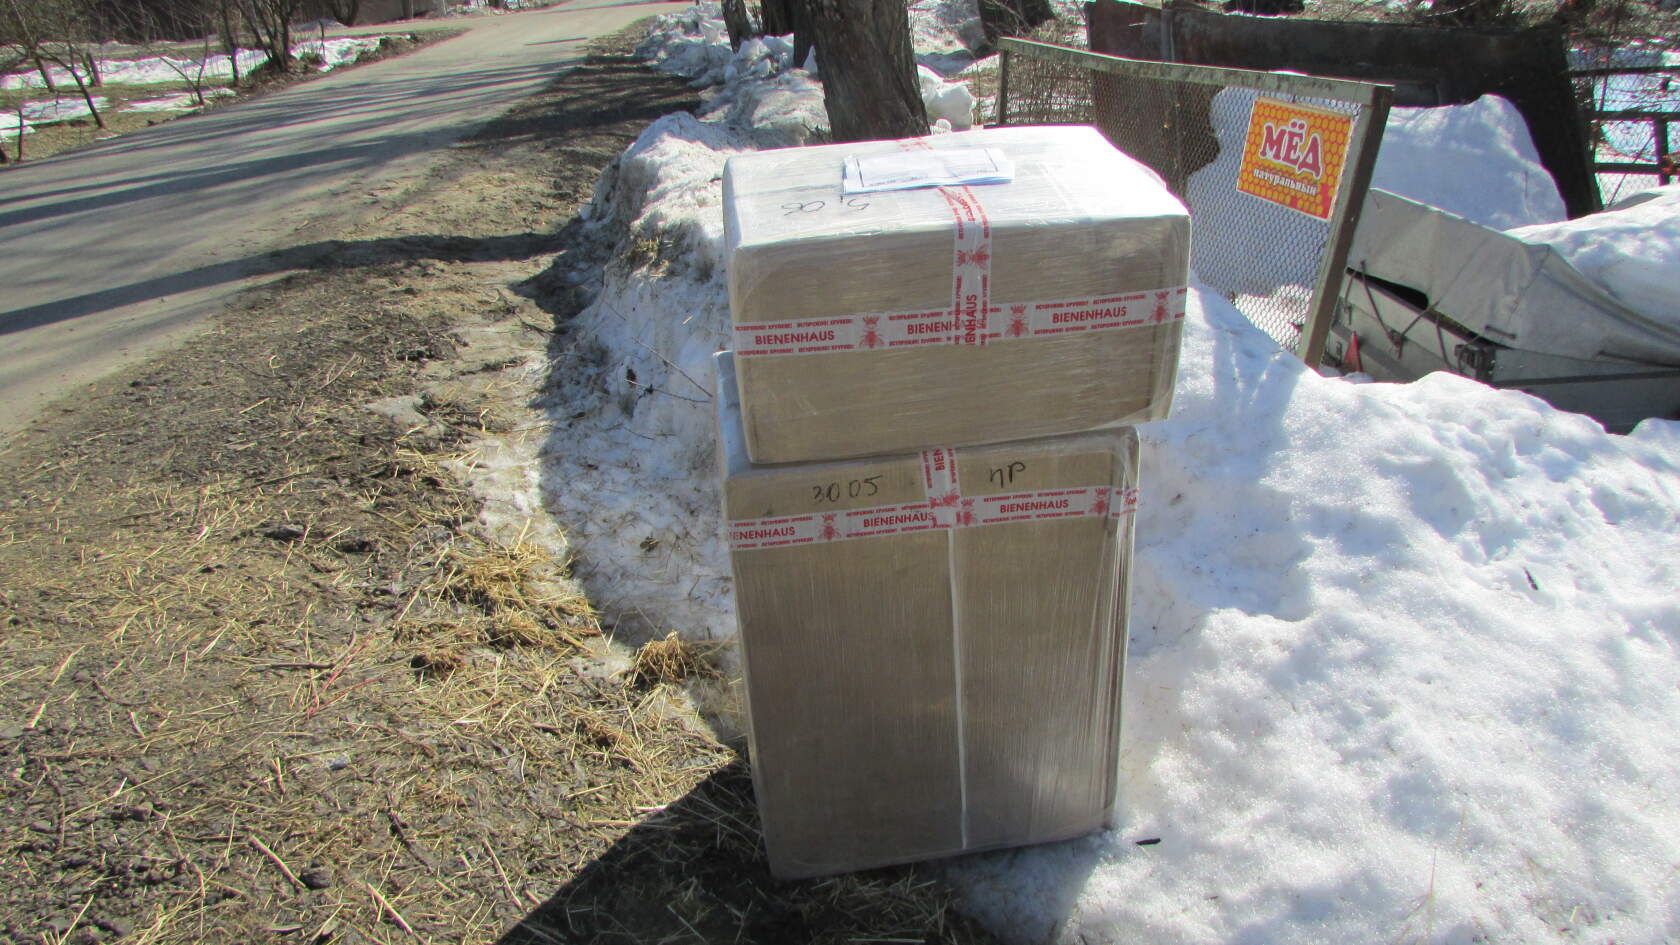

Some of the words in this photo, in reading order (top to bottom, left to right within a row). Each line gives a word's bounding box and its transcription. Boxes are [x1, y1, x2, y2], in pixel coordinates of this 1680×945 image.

[1259, 119, 1323, 180] МЁД
[1253, 168, 1317, 196] натуральный
[1052, 306, 1128, 324] BIENENHAUS
[755, 330, 835, 345] BIENENHAUS
[1000, 499, 1069, 513] BIENENHAUS
[863, 512, 934, 528] BIENENHAUS
